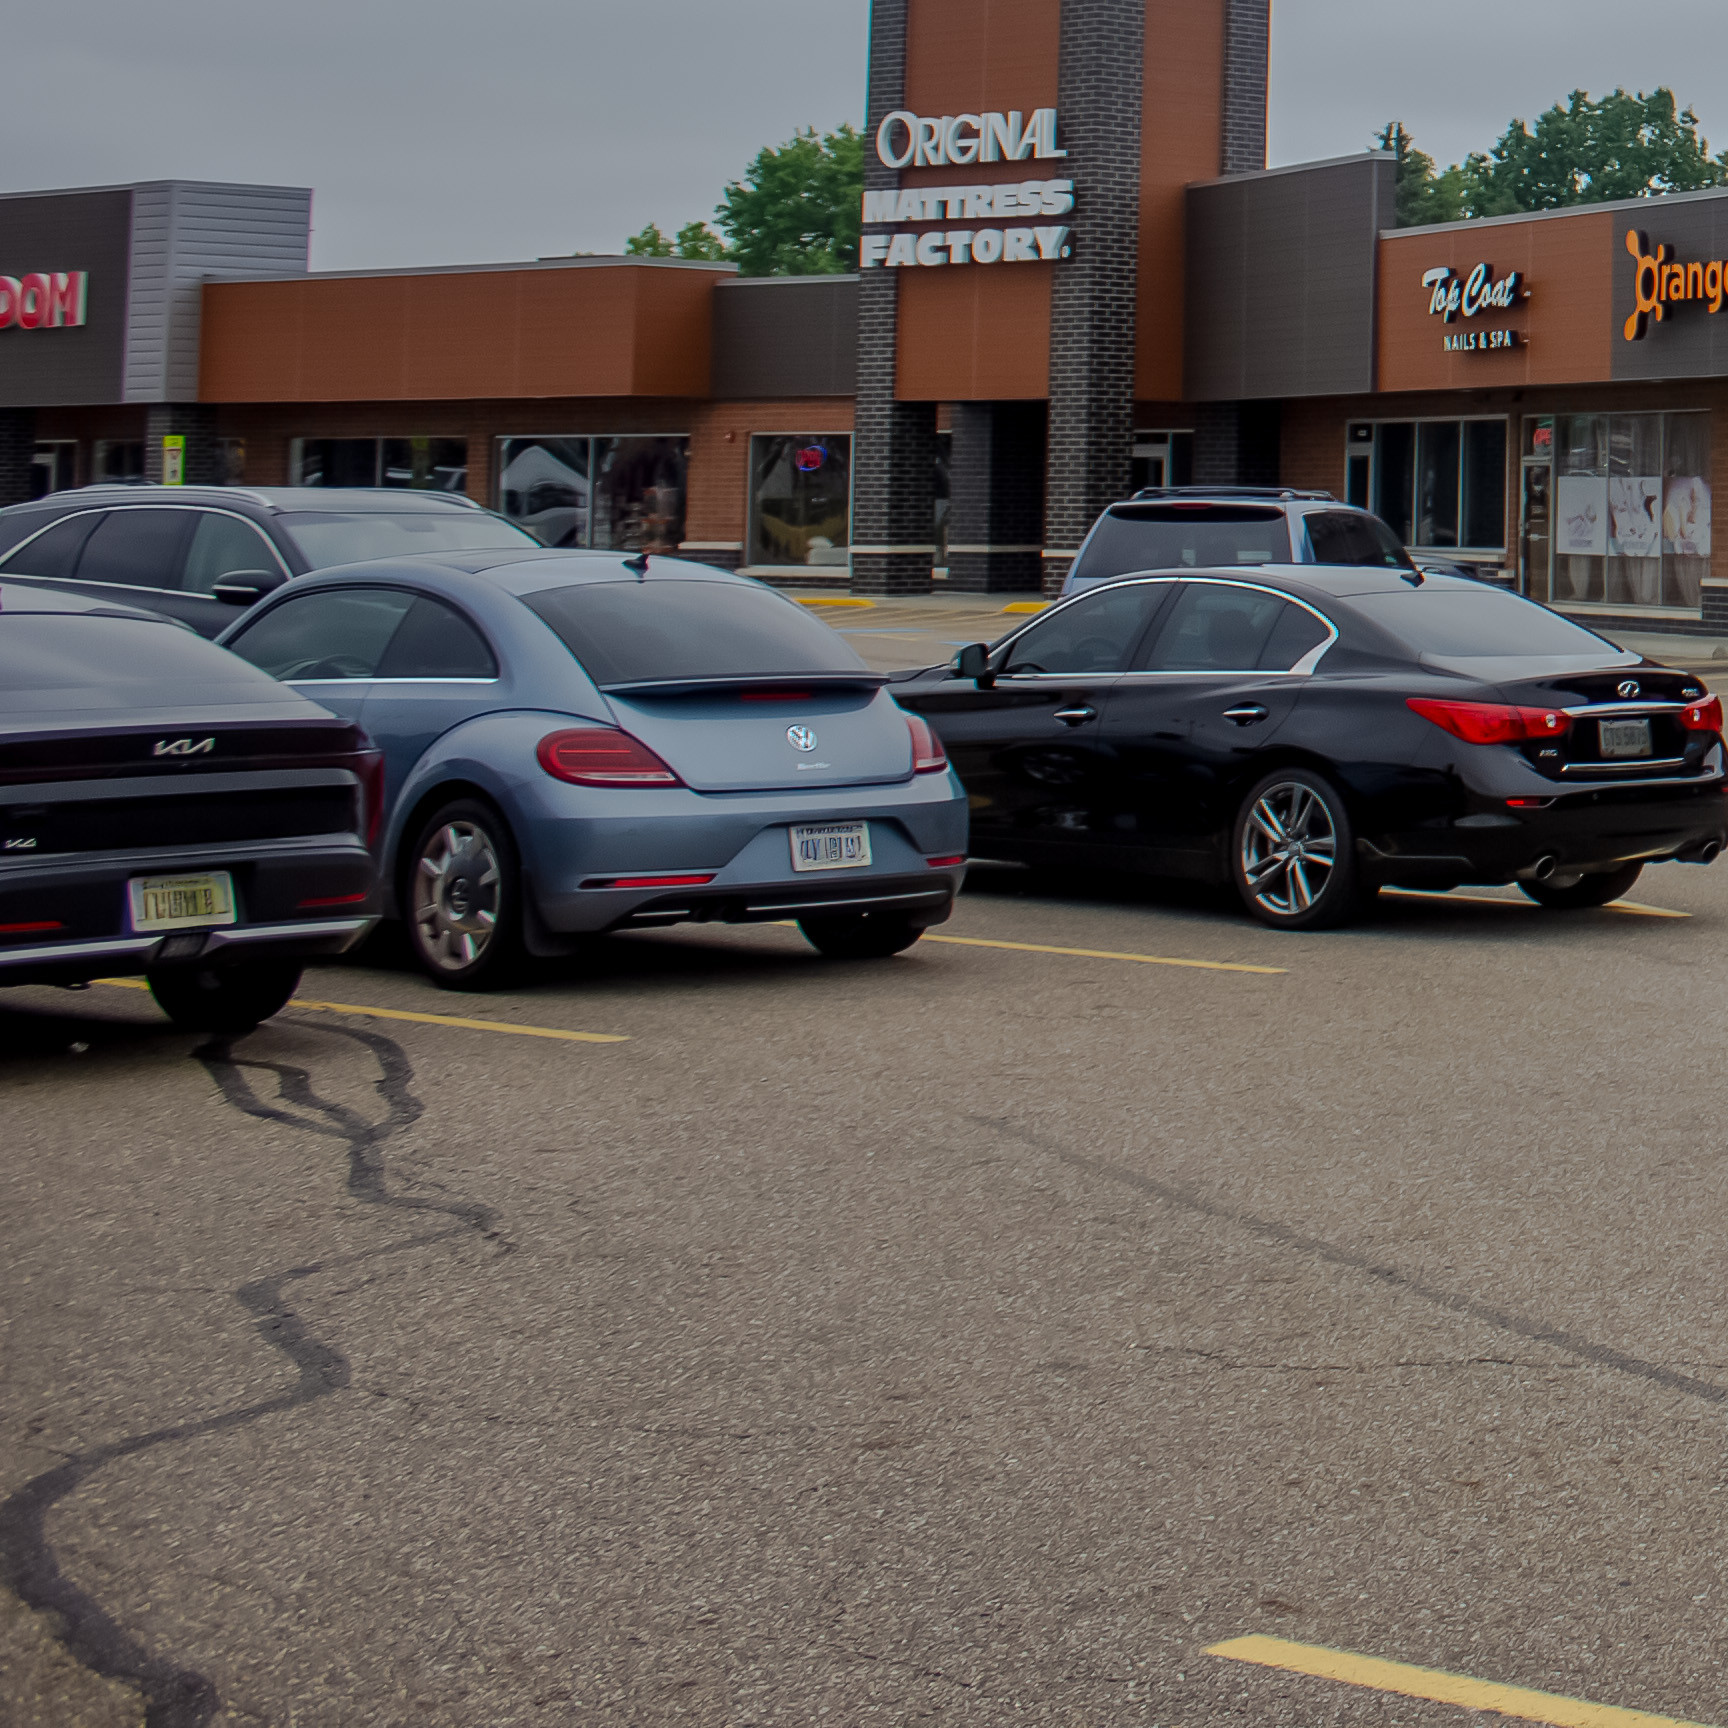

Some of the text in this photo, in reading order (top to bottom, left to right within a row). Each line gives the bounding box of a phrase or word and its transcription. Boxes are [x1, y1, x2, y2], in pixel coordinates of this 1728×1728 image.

[876, 108, 1068, 169] ORIGINAL
[861, 179, 1074, 223] MATTRESS
[1422, 262, 1516, 324] Top Coat
[1443, 333, 1476, 352] NAILS
[1489, 329, 1512, 348] SPA
